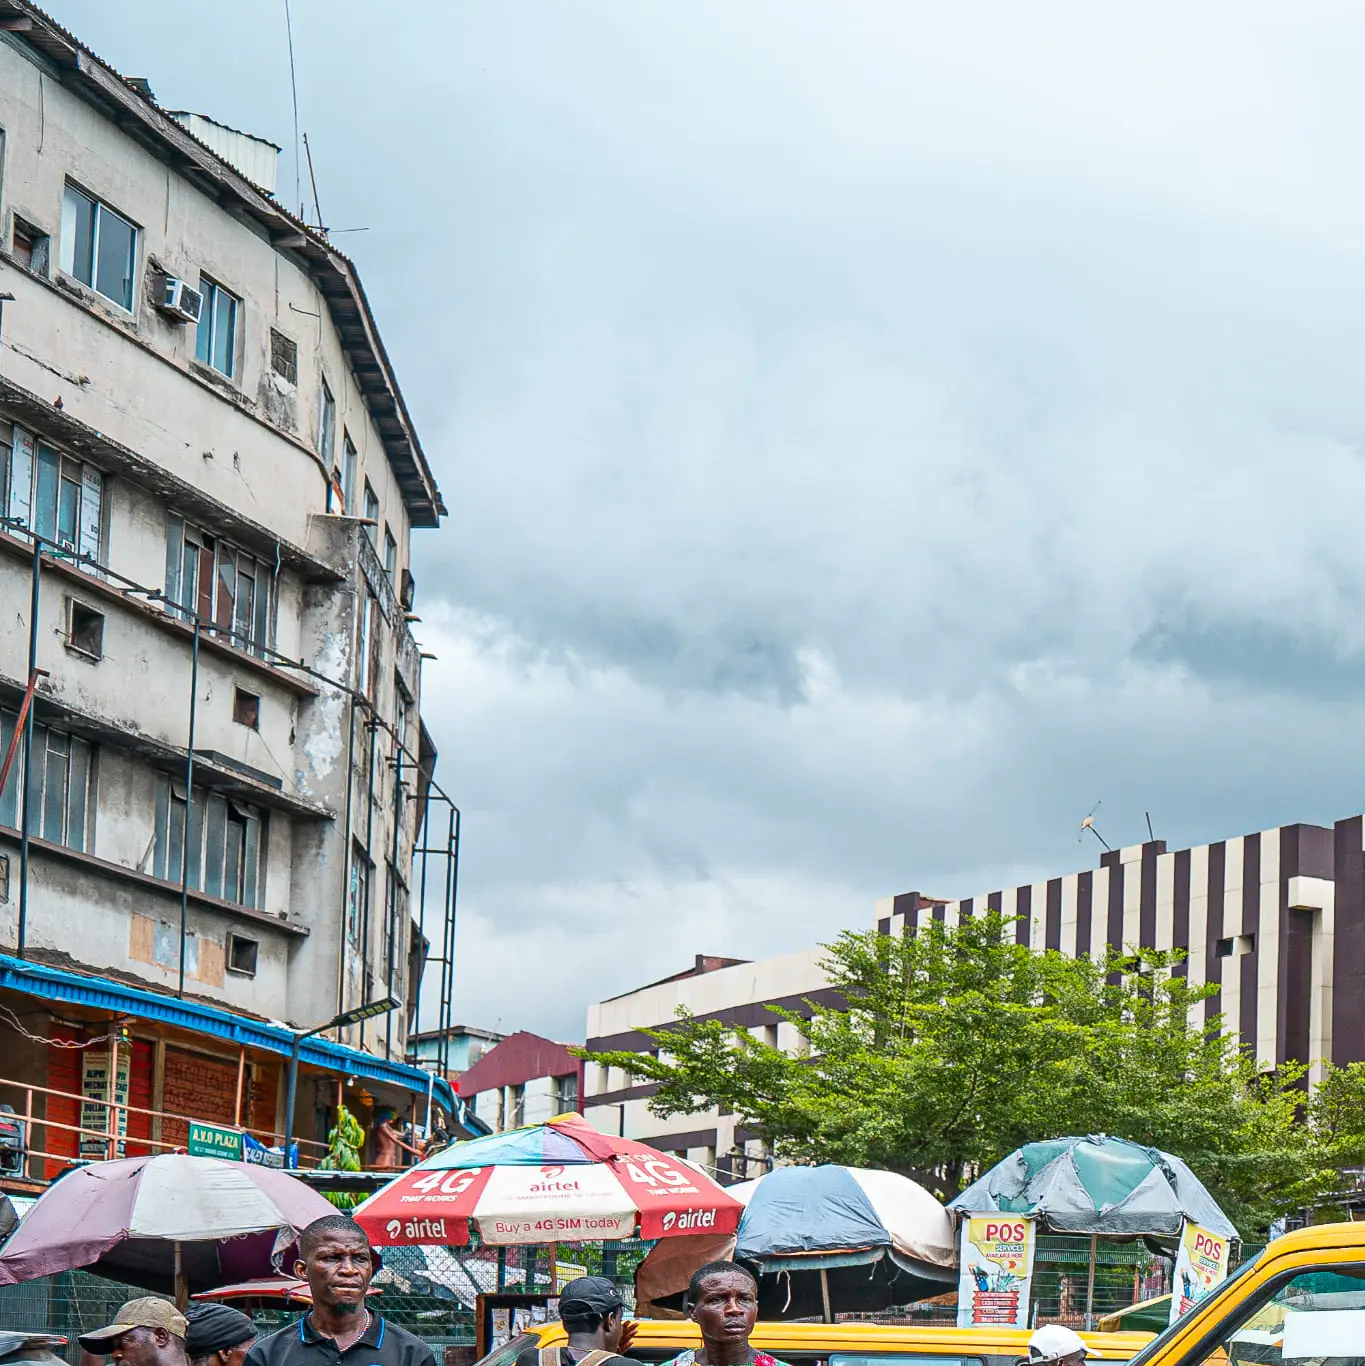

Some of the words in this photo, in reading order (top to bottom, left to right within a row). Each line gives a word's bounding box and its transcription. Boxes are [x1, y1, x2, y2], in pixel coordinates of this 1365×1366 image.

[192, 1128, 213, 1145] A.V.O
[214, 1133, 239, 1149] PLAZA
[411, 1168, 482, 1194] 4G
[627, 1160, 691, 1187] 4G
[529, 1181, 580, 1192] airtel
[405, 1216, 447, 1239] airtel
[495, 1222, 520, 1234] Buy
[523, 1223, 531, 1231] a
[535, 1219, 554, 1230] 4G
[556, 1218, 581, 1229] SIM
[585, 1217, 621, 1229] today
[677, 1208, 717, 1229] airtel
[986, 1223, 1025, 1242] POS
[995, 1243, 1025, 1252] SERVICES
[1195, 1233, 1222, 1260] POS
